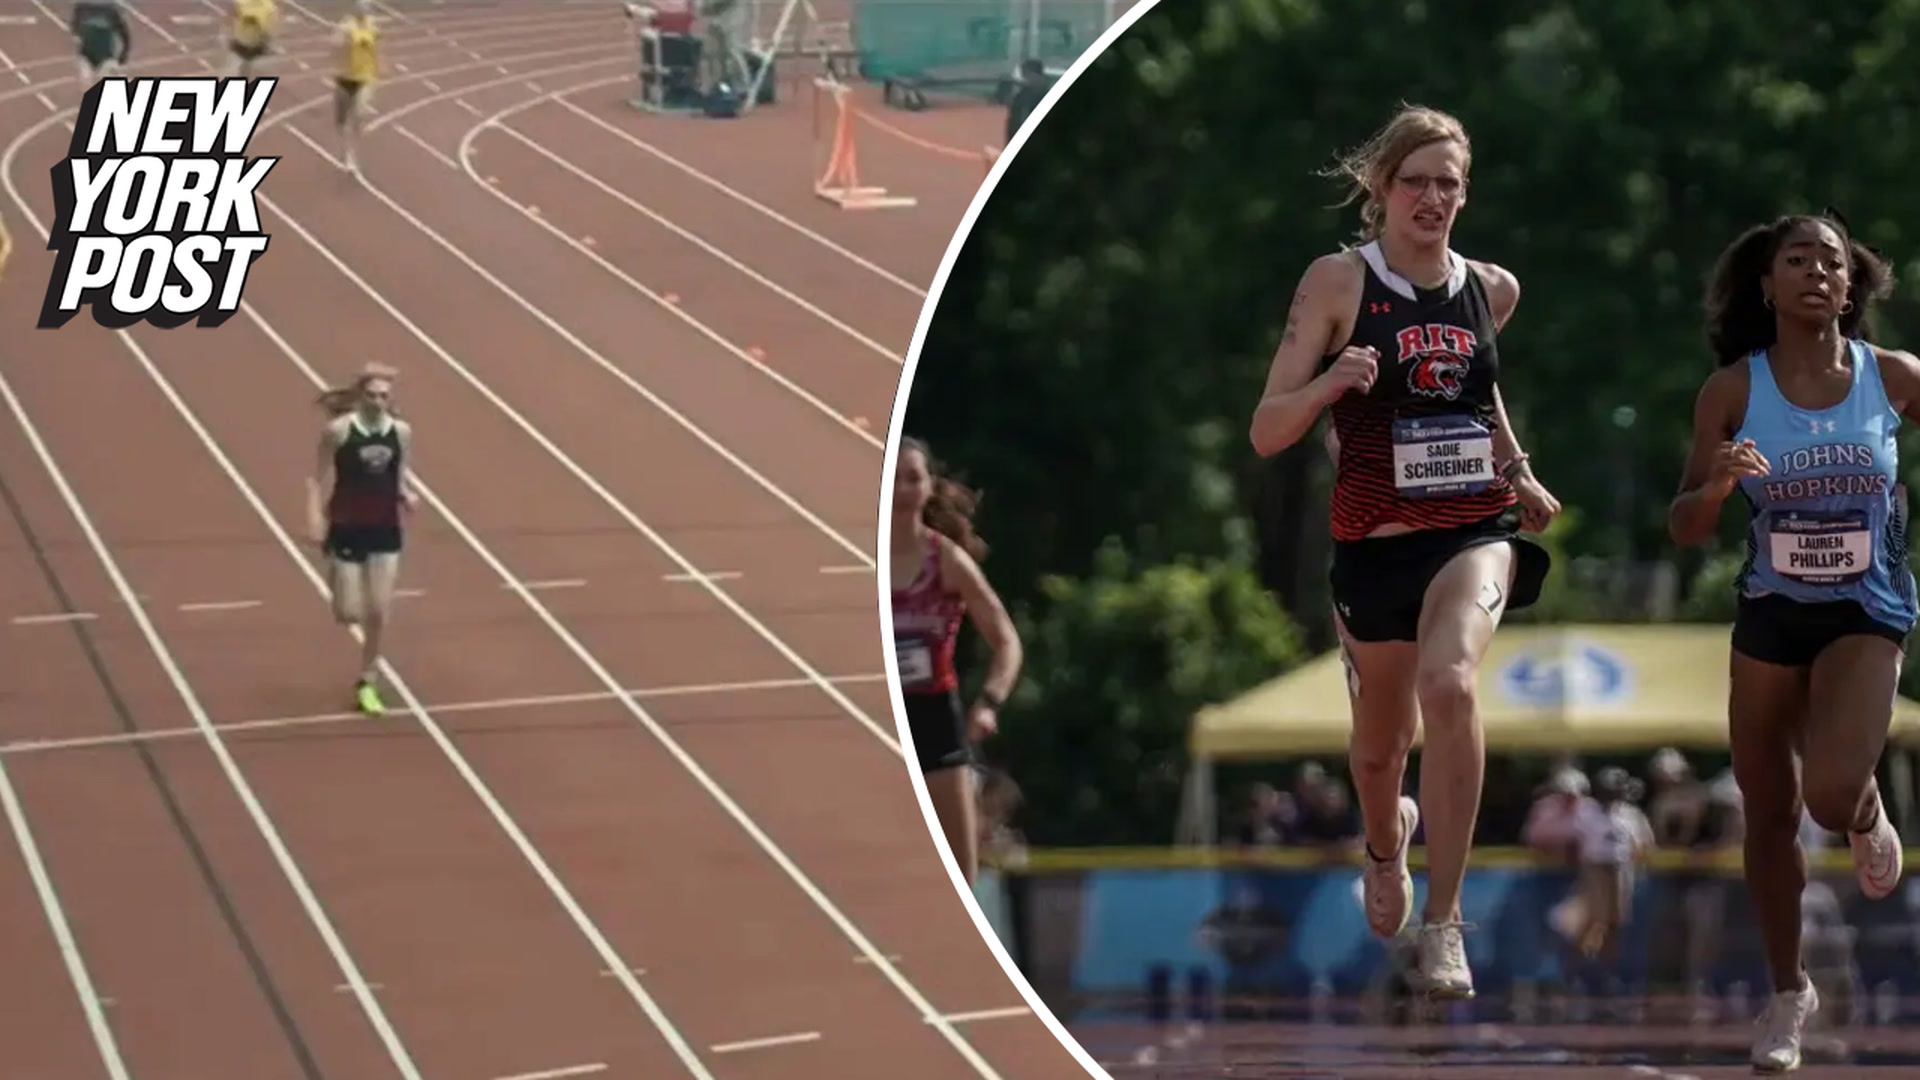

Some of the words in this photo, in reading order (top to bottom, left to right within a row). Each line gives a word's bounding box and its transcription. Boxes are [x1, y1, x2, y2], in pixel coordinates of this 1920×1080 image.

[1396, 323, 1477, 363] RIT
[1426, 442, 1461, 457] SADIE
[1780, 443, 1874, 475] JOHNS
[1404, 458, 1484, 479] SCHREINER
[1764, 474, 1888, 501] HOPKINS
[1798, 536, 1844, 550] LAUREN
[1789, 551, 1854, 568] PHILLIPS
